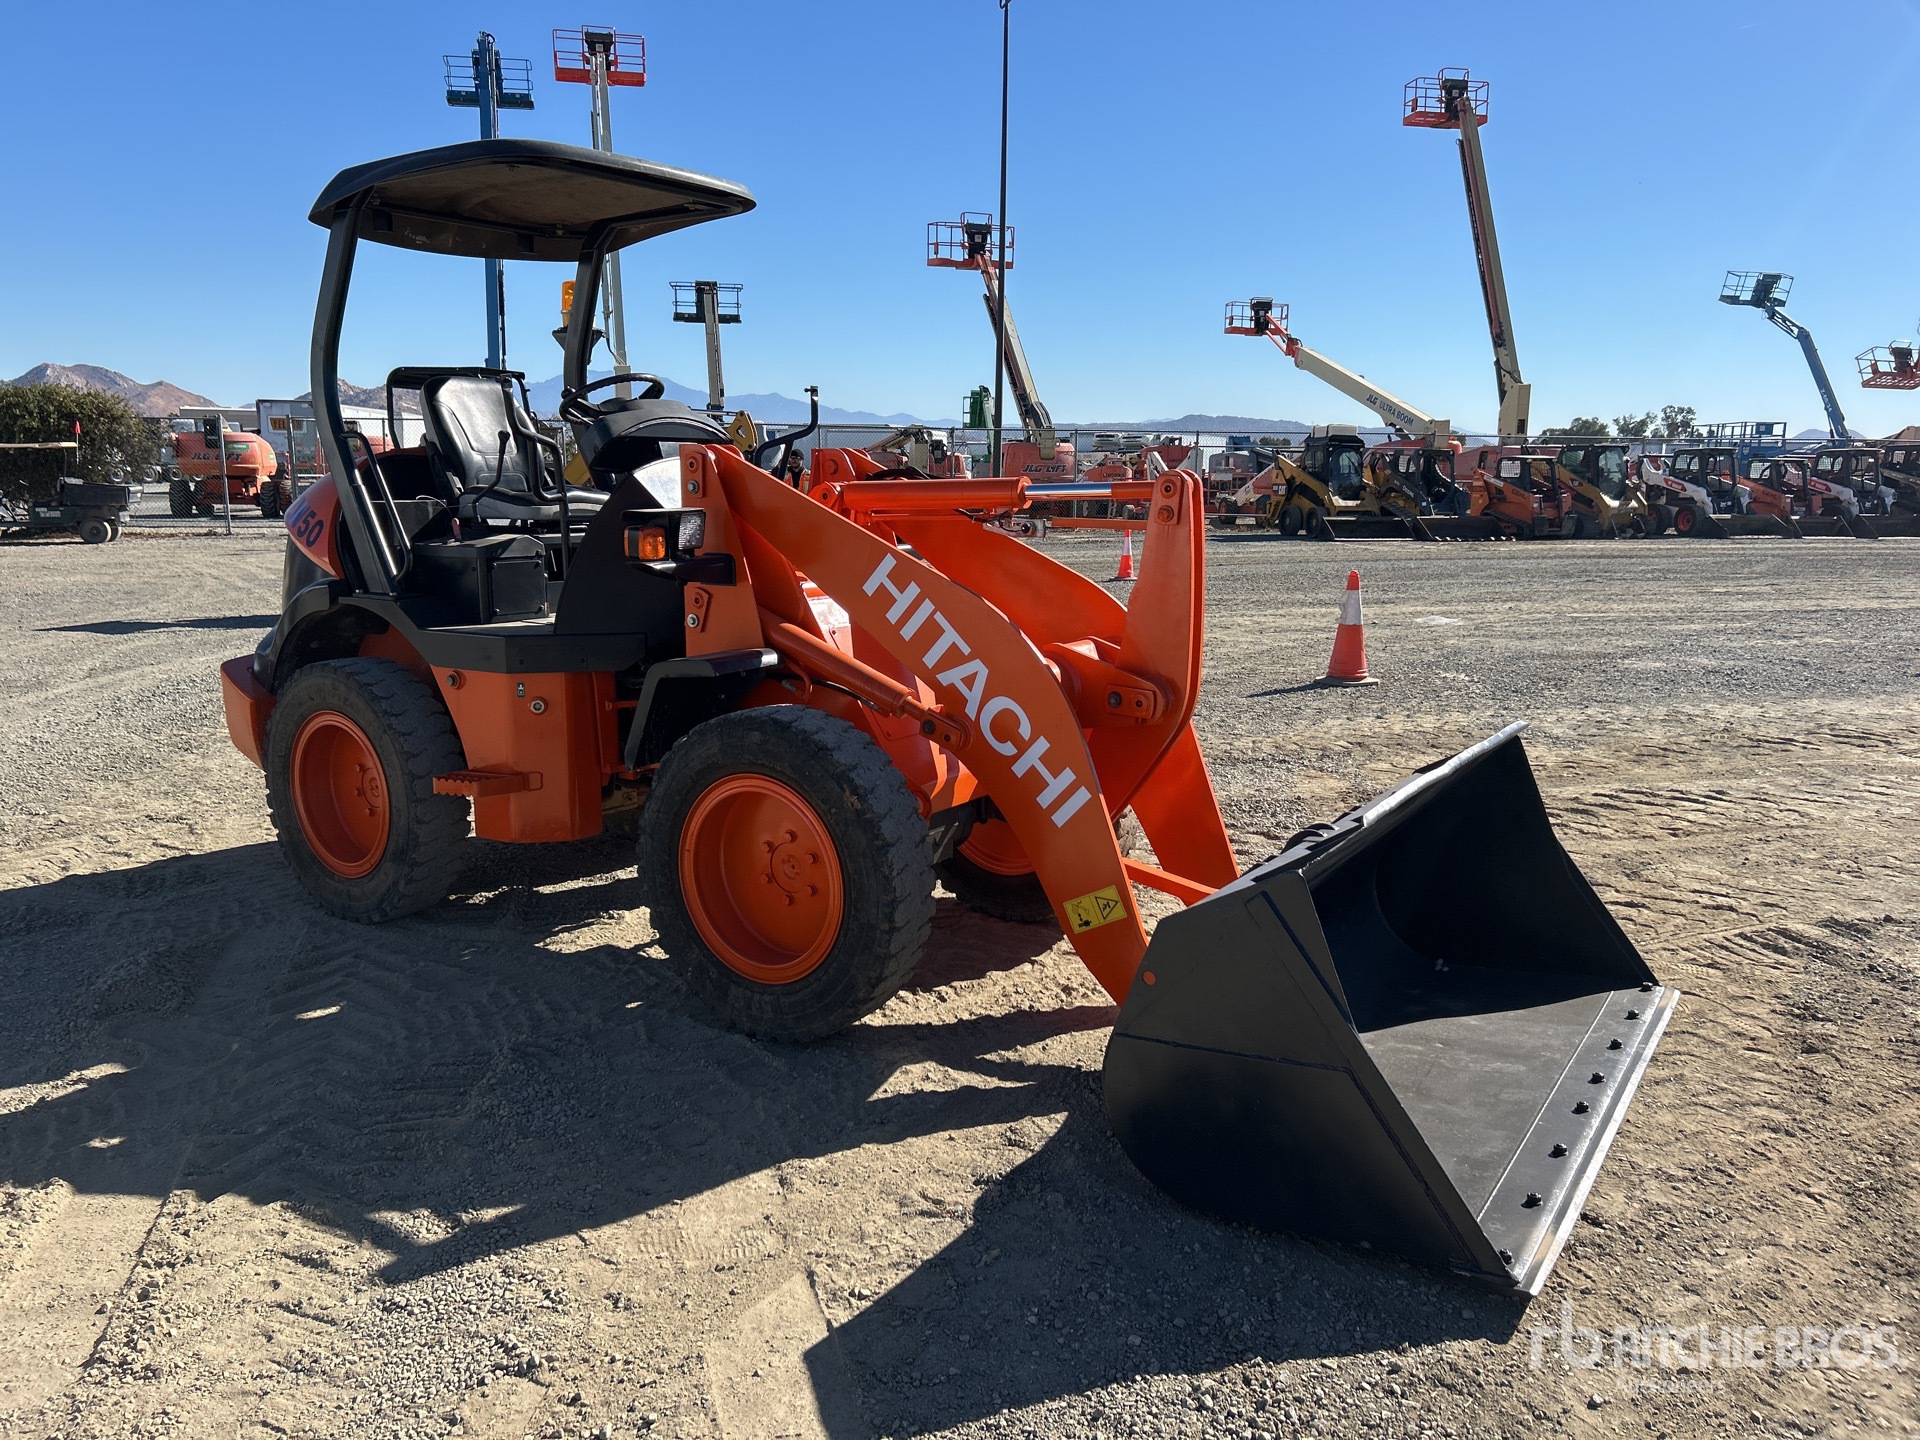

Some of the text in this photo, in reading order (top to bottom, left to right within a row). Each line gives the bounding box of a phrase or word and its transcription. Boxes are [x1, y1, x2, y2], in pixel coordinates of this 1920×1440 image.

[1366, 393, 1414, 427] JLG ULTRA BOOM
[1022, 464, 1067, 473] JLG LIFT
[862, 553, 1092, 828] HITACHI
